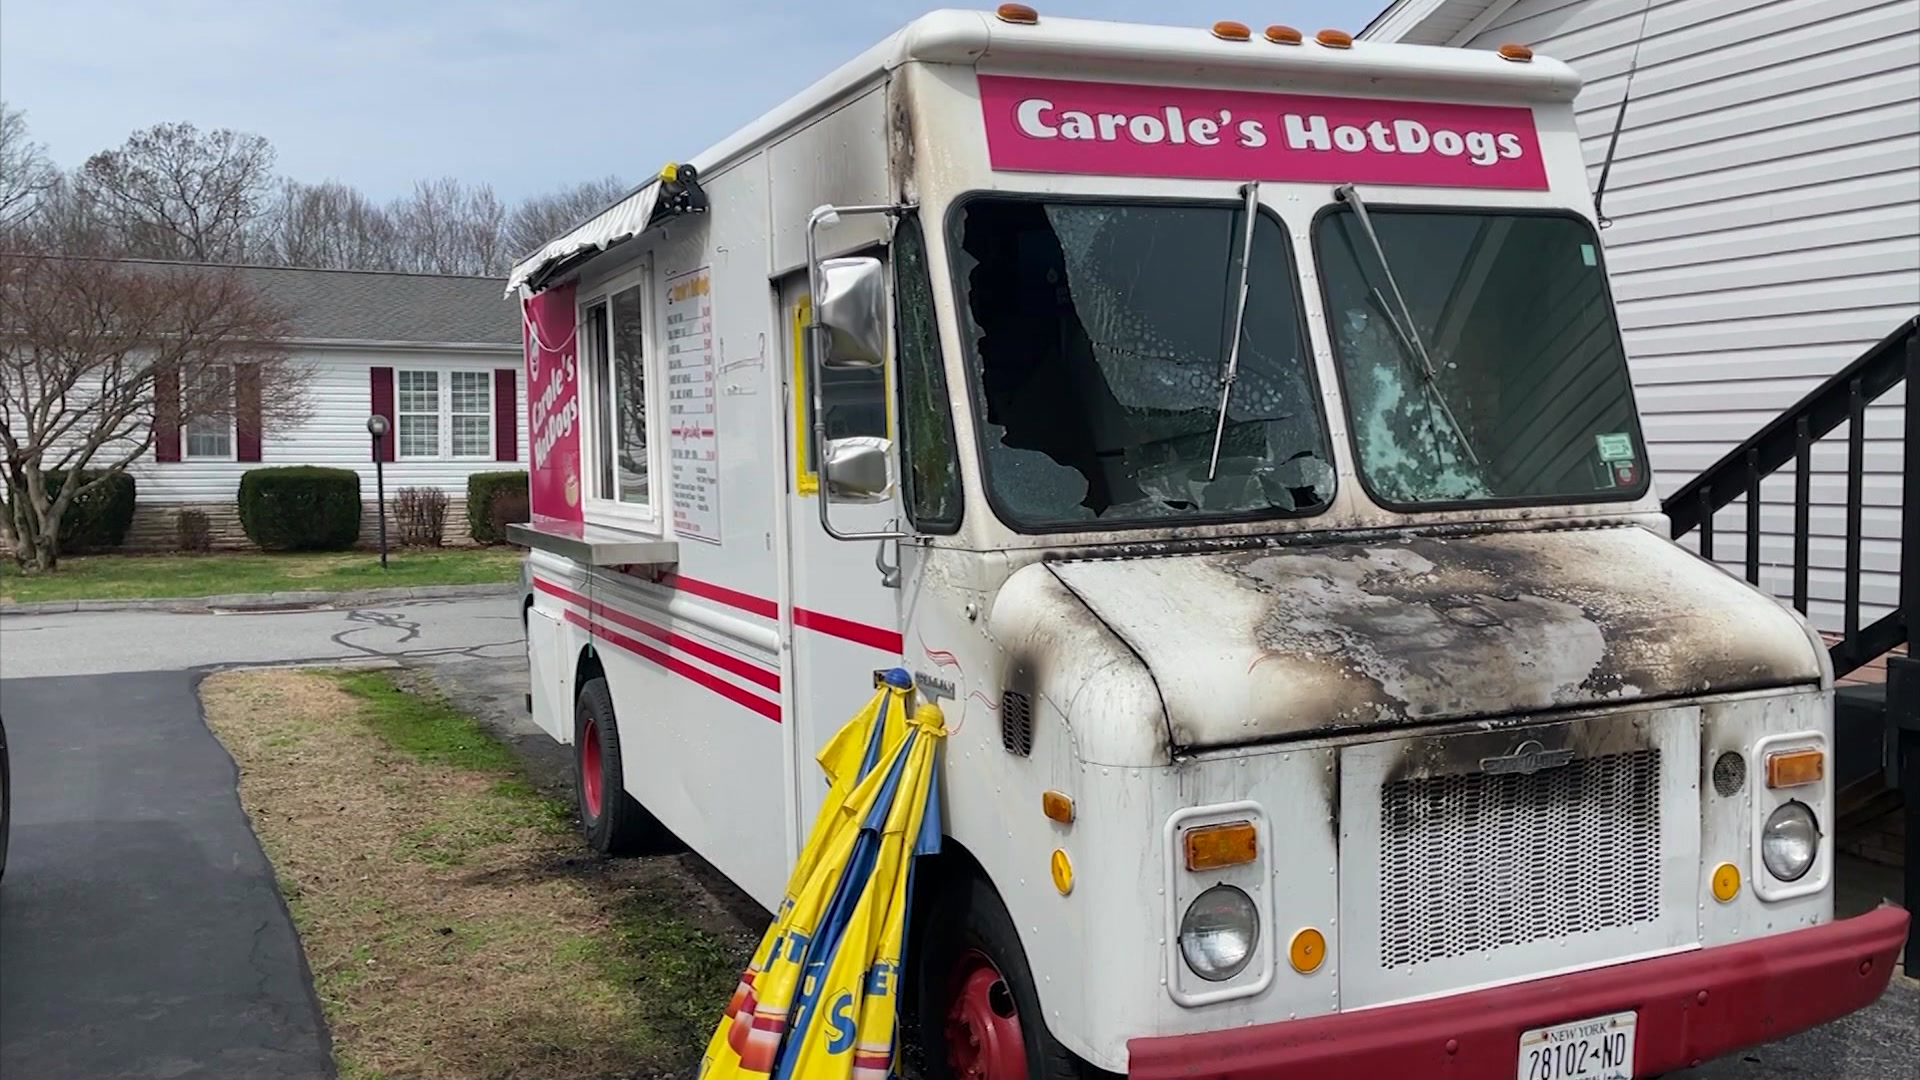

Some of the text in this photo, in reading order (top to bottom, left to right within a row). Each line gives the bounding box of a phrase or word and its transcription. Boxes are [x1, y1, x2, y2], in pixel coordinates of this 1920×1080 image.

[1015, 97, 1524, 167] Carole's HotDogs
[532, 353, 575, 435] Carole's
[1550, 1021, 1609, 1043] NEW YORK
